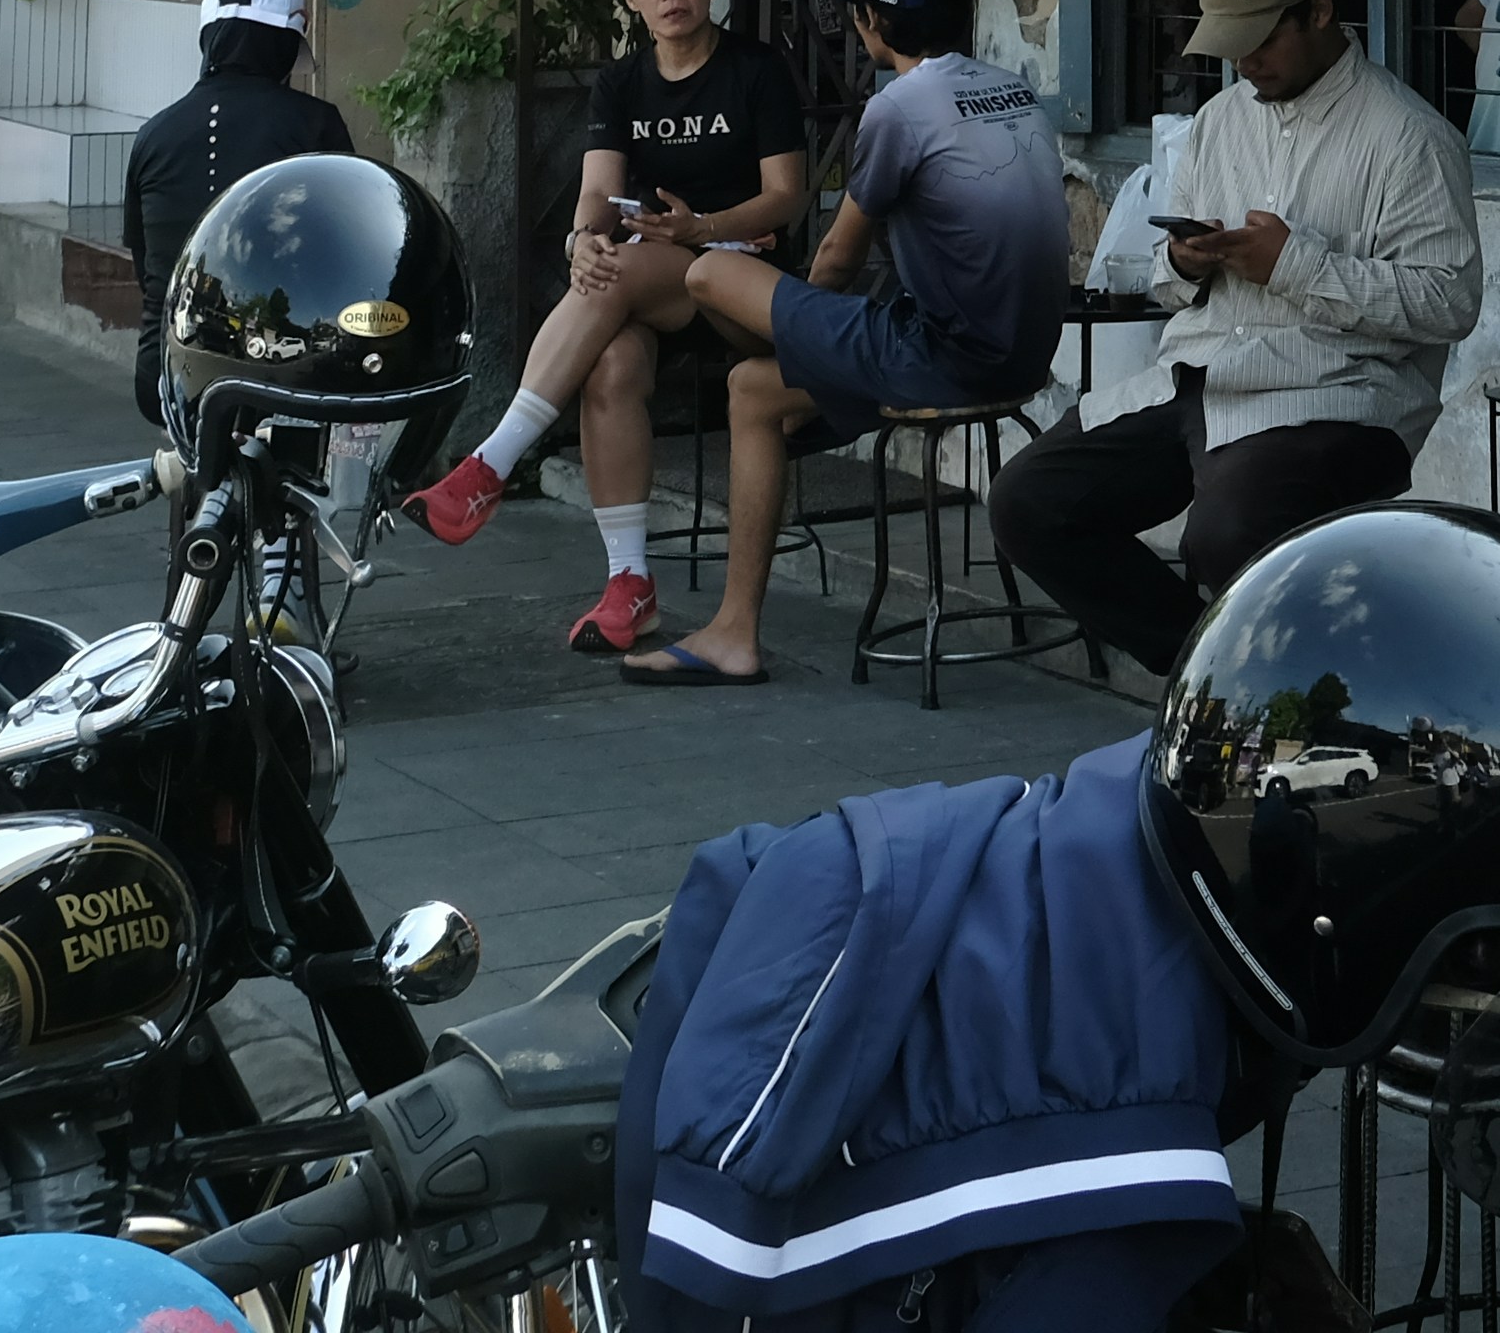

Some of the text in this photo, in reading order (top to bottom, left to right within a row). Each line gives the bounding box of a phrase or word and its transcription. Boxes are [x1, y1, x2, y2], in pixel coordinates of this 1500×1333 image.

[954, 89, 1039, 118] FINISHER
[631, 112, 731, 140] NONA
[55, 882, 154, 930] ROYAL
[61, 914, 170, 973] ENFIELD
